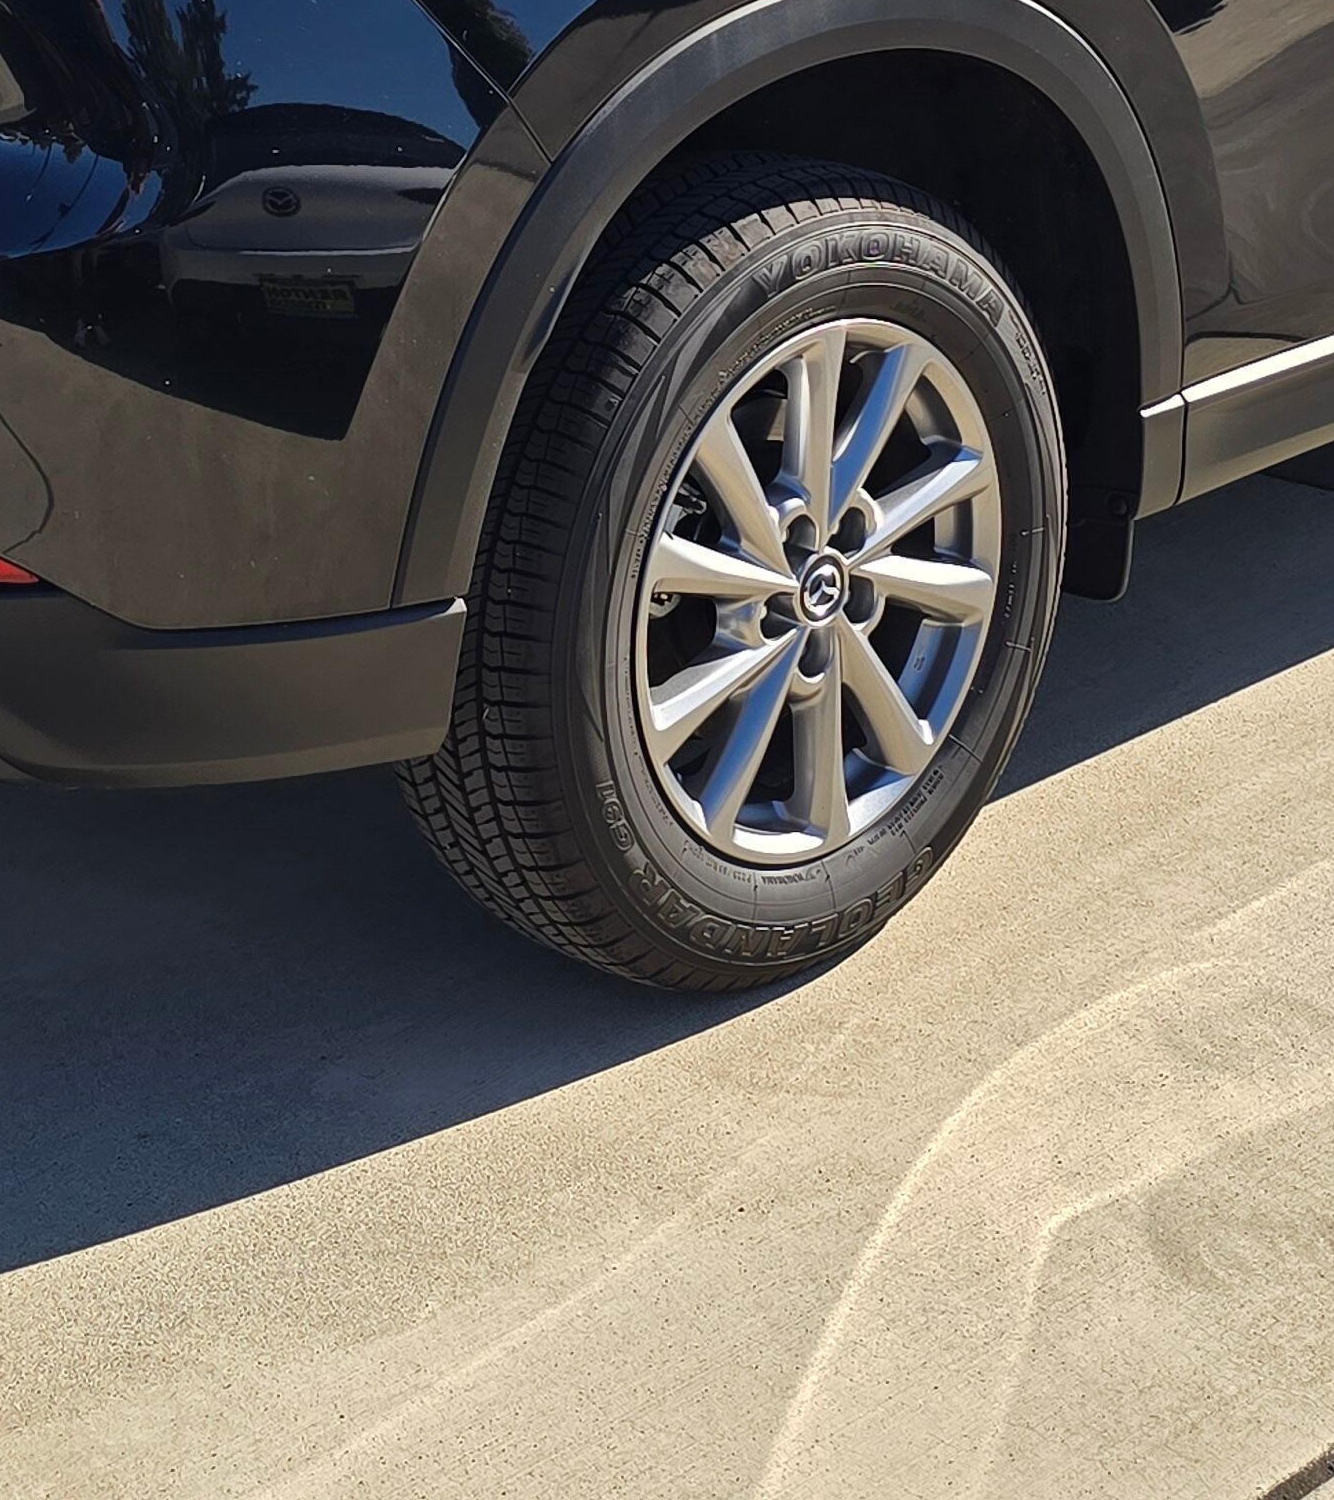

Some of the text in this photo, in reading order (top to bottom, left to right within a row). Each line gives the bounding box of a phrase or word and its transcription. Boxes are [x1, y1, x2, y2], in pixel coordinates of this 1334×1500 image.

[751, 229, 1006, 328] YOKOHAMA
[595, 779, 934, 957] GEOLANDAR G91
